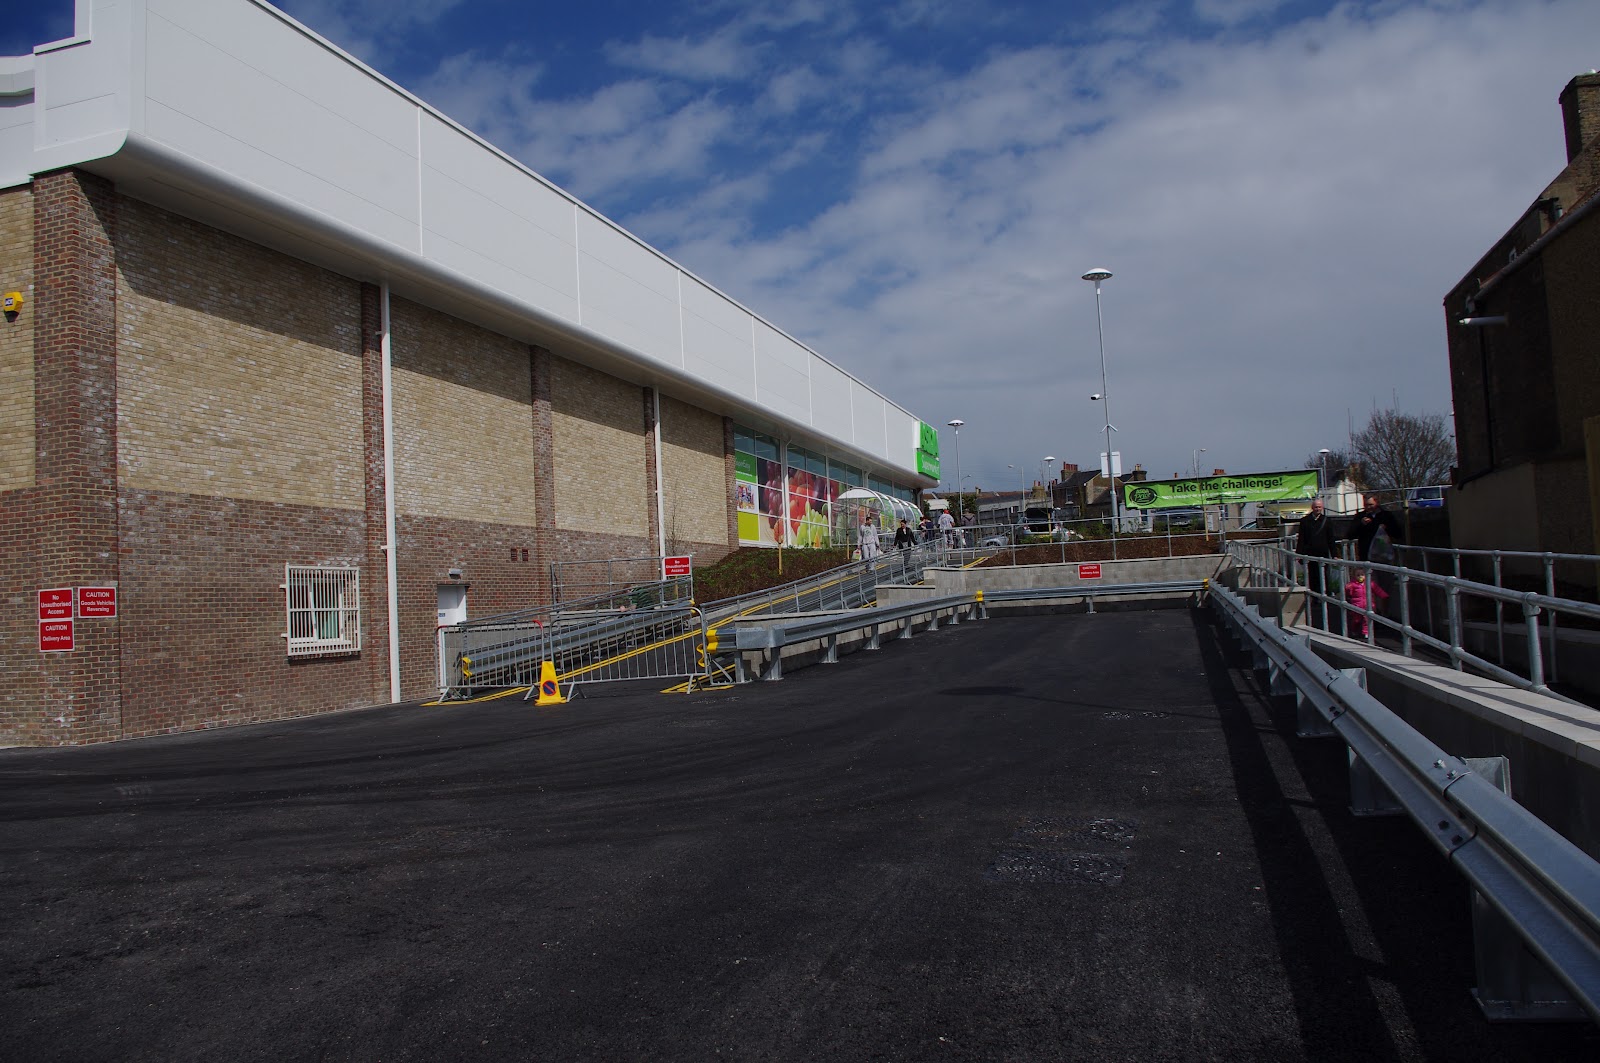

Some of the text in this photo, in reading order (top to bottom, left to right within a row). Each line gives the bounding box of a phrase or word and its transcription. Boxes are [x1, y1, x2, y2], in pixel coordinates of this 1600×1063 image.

[1170, 477, 1283, 493] Take the challenge!
[41, 600, 72, 608] Unauthorised
